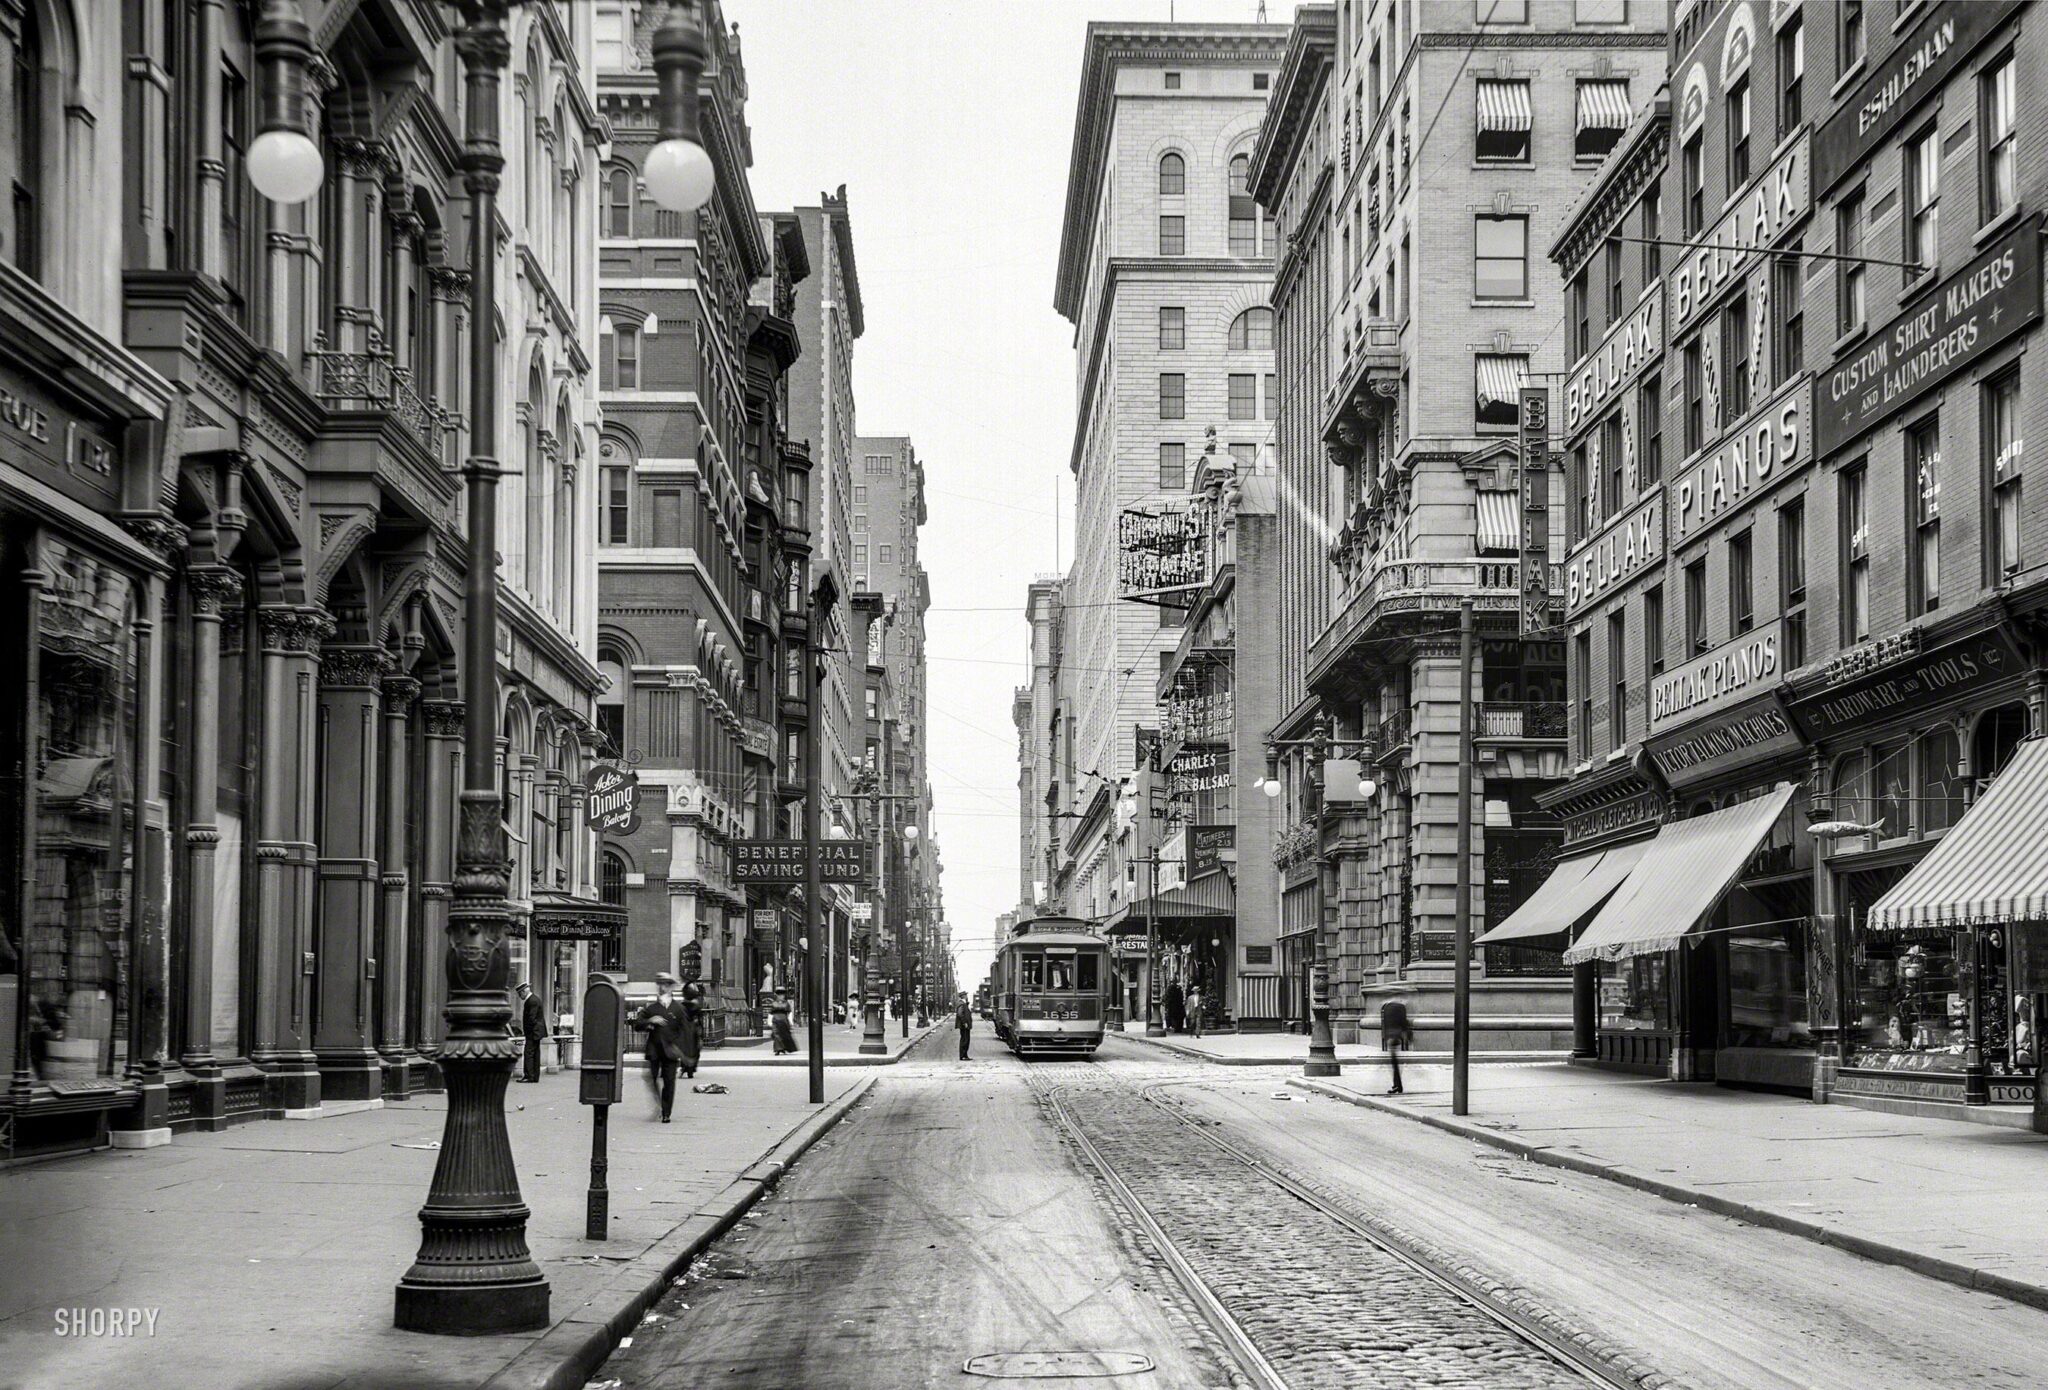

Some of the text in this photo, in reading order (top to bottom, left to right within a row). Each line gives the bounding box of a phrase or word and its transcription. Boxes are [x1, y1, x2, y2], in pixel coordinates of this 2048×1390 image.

[1859, 18, 1955, 137] ESHLEMAN
[1678, 155, 1796, 324] BELLAK
[1832, 248, 2014, 402] CUSTOM SHIRT MAKERS
[1569, 303, 1654, 430] BELLAK
[1861, 315, 1978, 413] AND LAUNDERERS
[1680, 400, 1798, 535] PIANOS
[1524, 396, 1548, 634] BELLAK
[1570, 507, 1654, 608] BELLAK
[1654, 633, 1776, 722] BELLAK PIANOS
[1822, 653, 1979, 724] HARDWARE AND TOOLS
[1171, 754, 1216, 773] CHARLES
[1652, 709, 1788, 775] VICTOR TALKING MACHINES
[590, 786, 634, 820] Dining
[594, 772, 624, 793] Acker
[1192, 774, 1231, 792] BALSAR
[1601, 802, 1637, 832] FLETCHER
[602, 811, 632, 829] Balcony
[736, 864, 860, 877] SAVING UND
[1992, 1087, 2035, 1100] TOO
